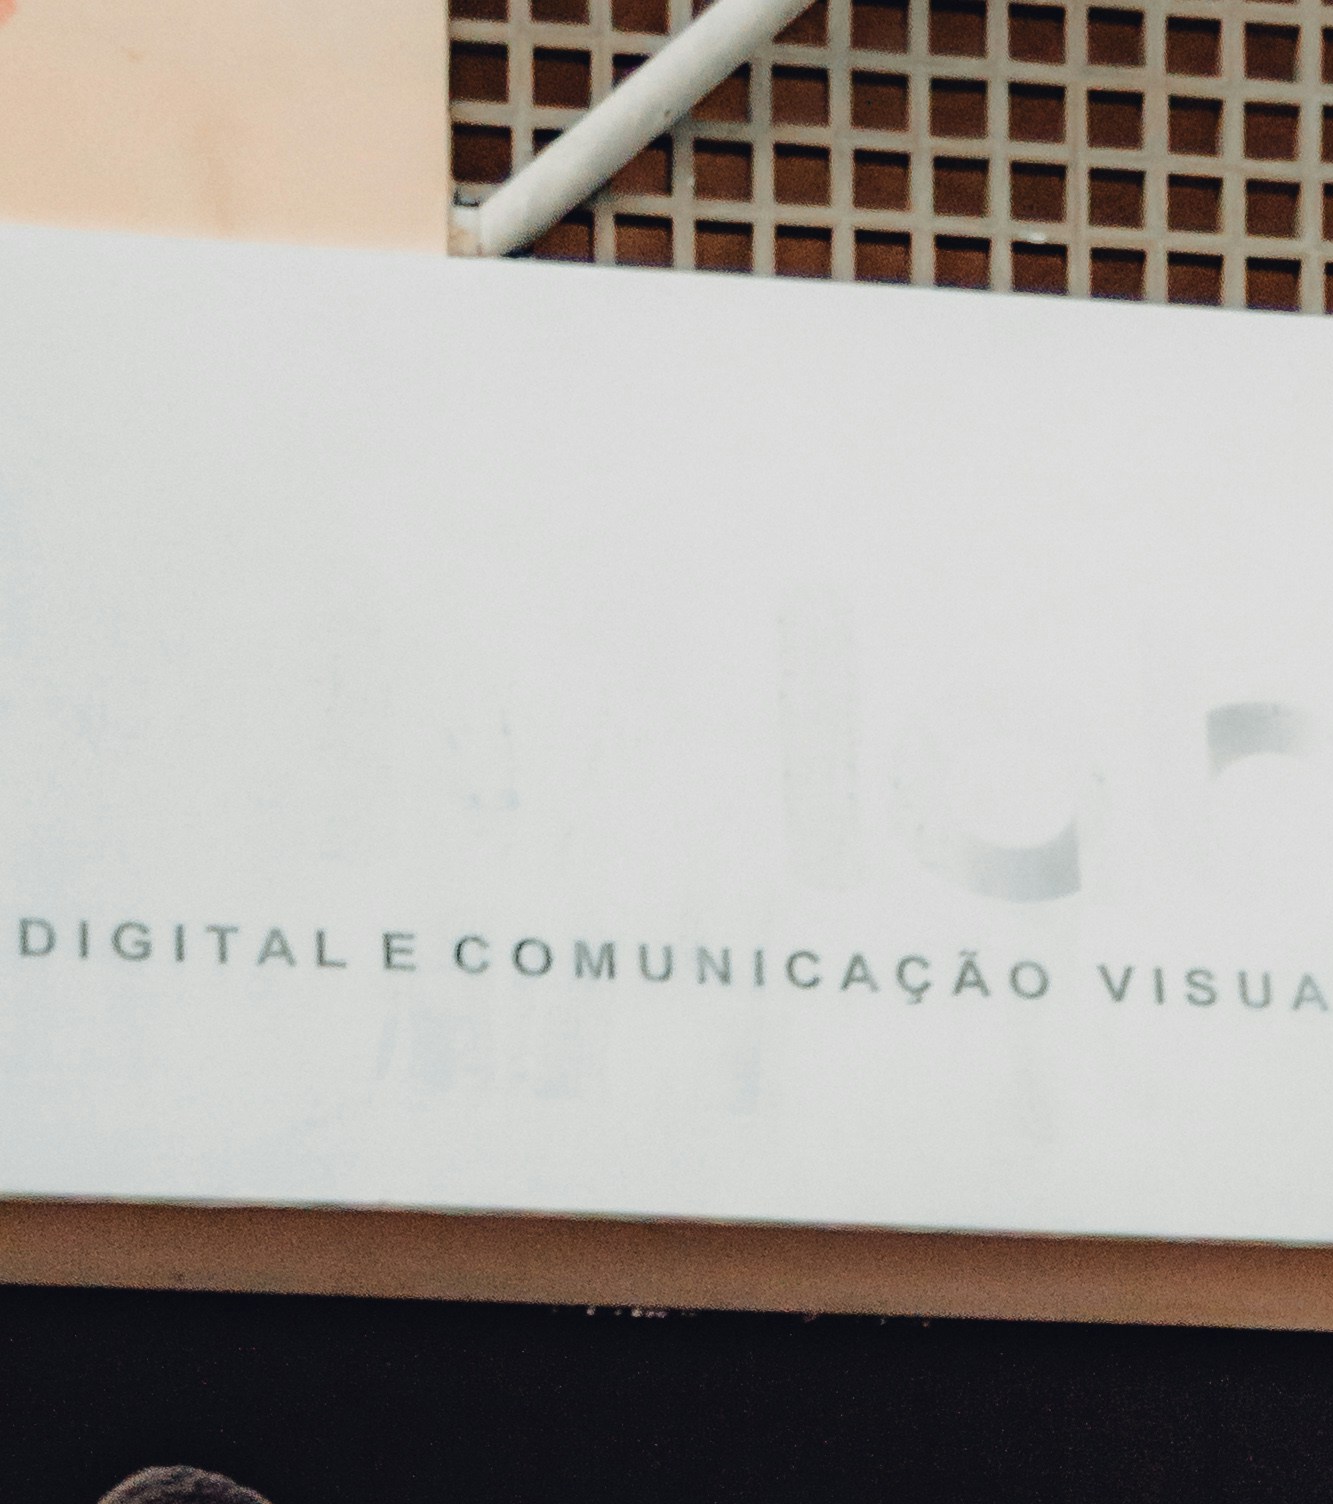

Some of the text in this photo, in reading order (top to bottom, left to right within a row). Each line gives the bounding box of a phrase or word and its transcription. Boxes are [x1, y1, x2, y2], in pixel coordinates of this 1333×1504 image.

[18, 916, 348, 969] DIGITAL
[381, 931, 417, 974] E
[453, 933, 1050, 1005] COMUNICAÇÃO
